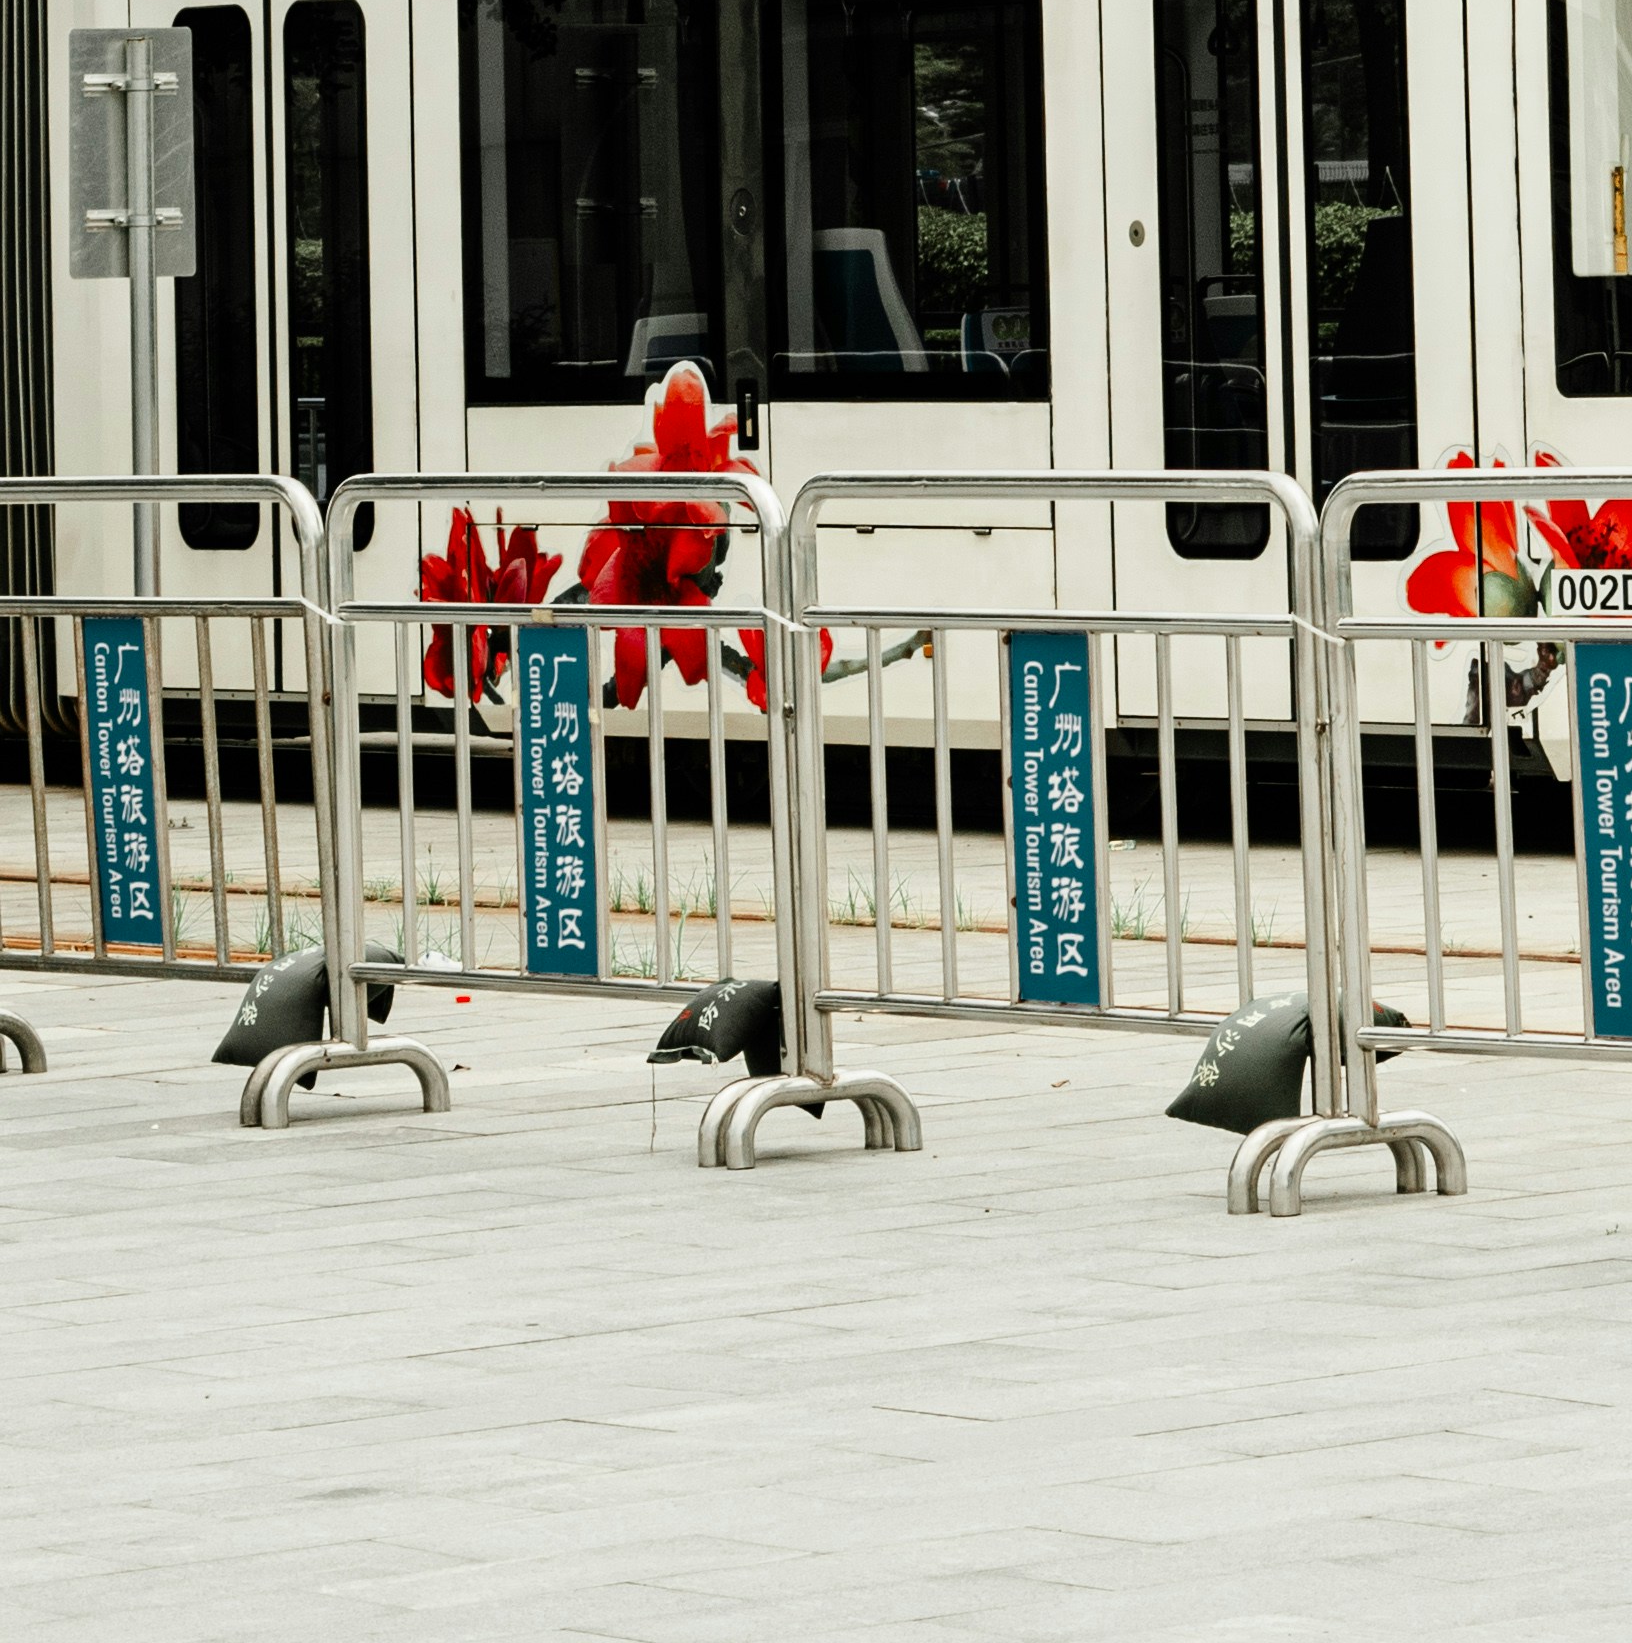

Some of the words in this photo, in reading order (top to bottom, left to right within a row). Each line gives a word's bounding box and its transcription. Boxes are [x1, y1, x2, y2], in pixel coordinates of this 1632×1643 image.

[94, 642, 110, 713] Canton
[528, 653, 545, 728] Canton
[1023, 660, 1044, 741] Canton
[98, 720, 113, 777] Tower
[1589, 673, 1612, 758] Canton
[114, 642, 154, 920] 广州塔旅游区
[530, 735, 547, 798] Tower
[548, 653, 586, 950] 广州塔旅游区
[1024, 748, 1044, 816] Tower
[1595, 766, 1618, 838] Tower
[102, 786, 118, 863] Tourism
[533, 805, 551, 888] Tourism
[1048, 662, 1088, 977] 广州塔旅游区
[108, 869, 123, 918] Area
[1025, 823, 1045, 911] Tourism
[1600, 845, 1623, 940] Tourism
[535, 895, 551, 948] Area
[1029, 918, 1048, 974] Area
[1604, 947, 1625, 1008] Area
